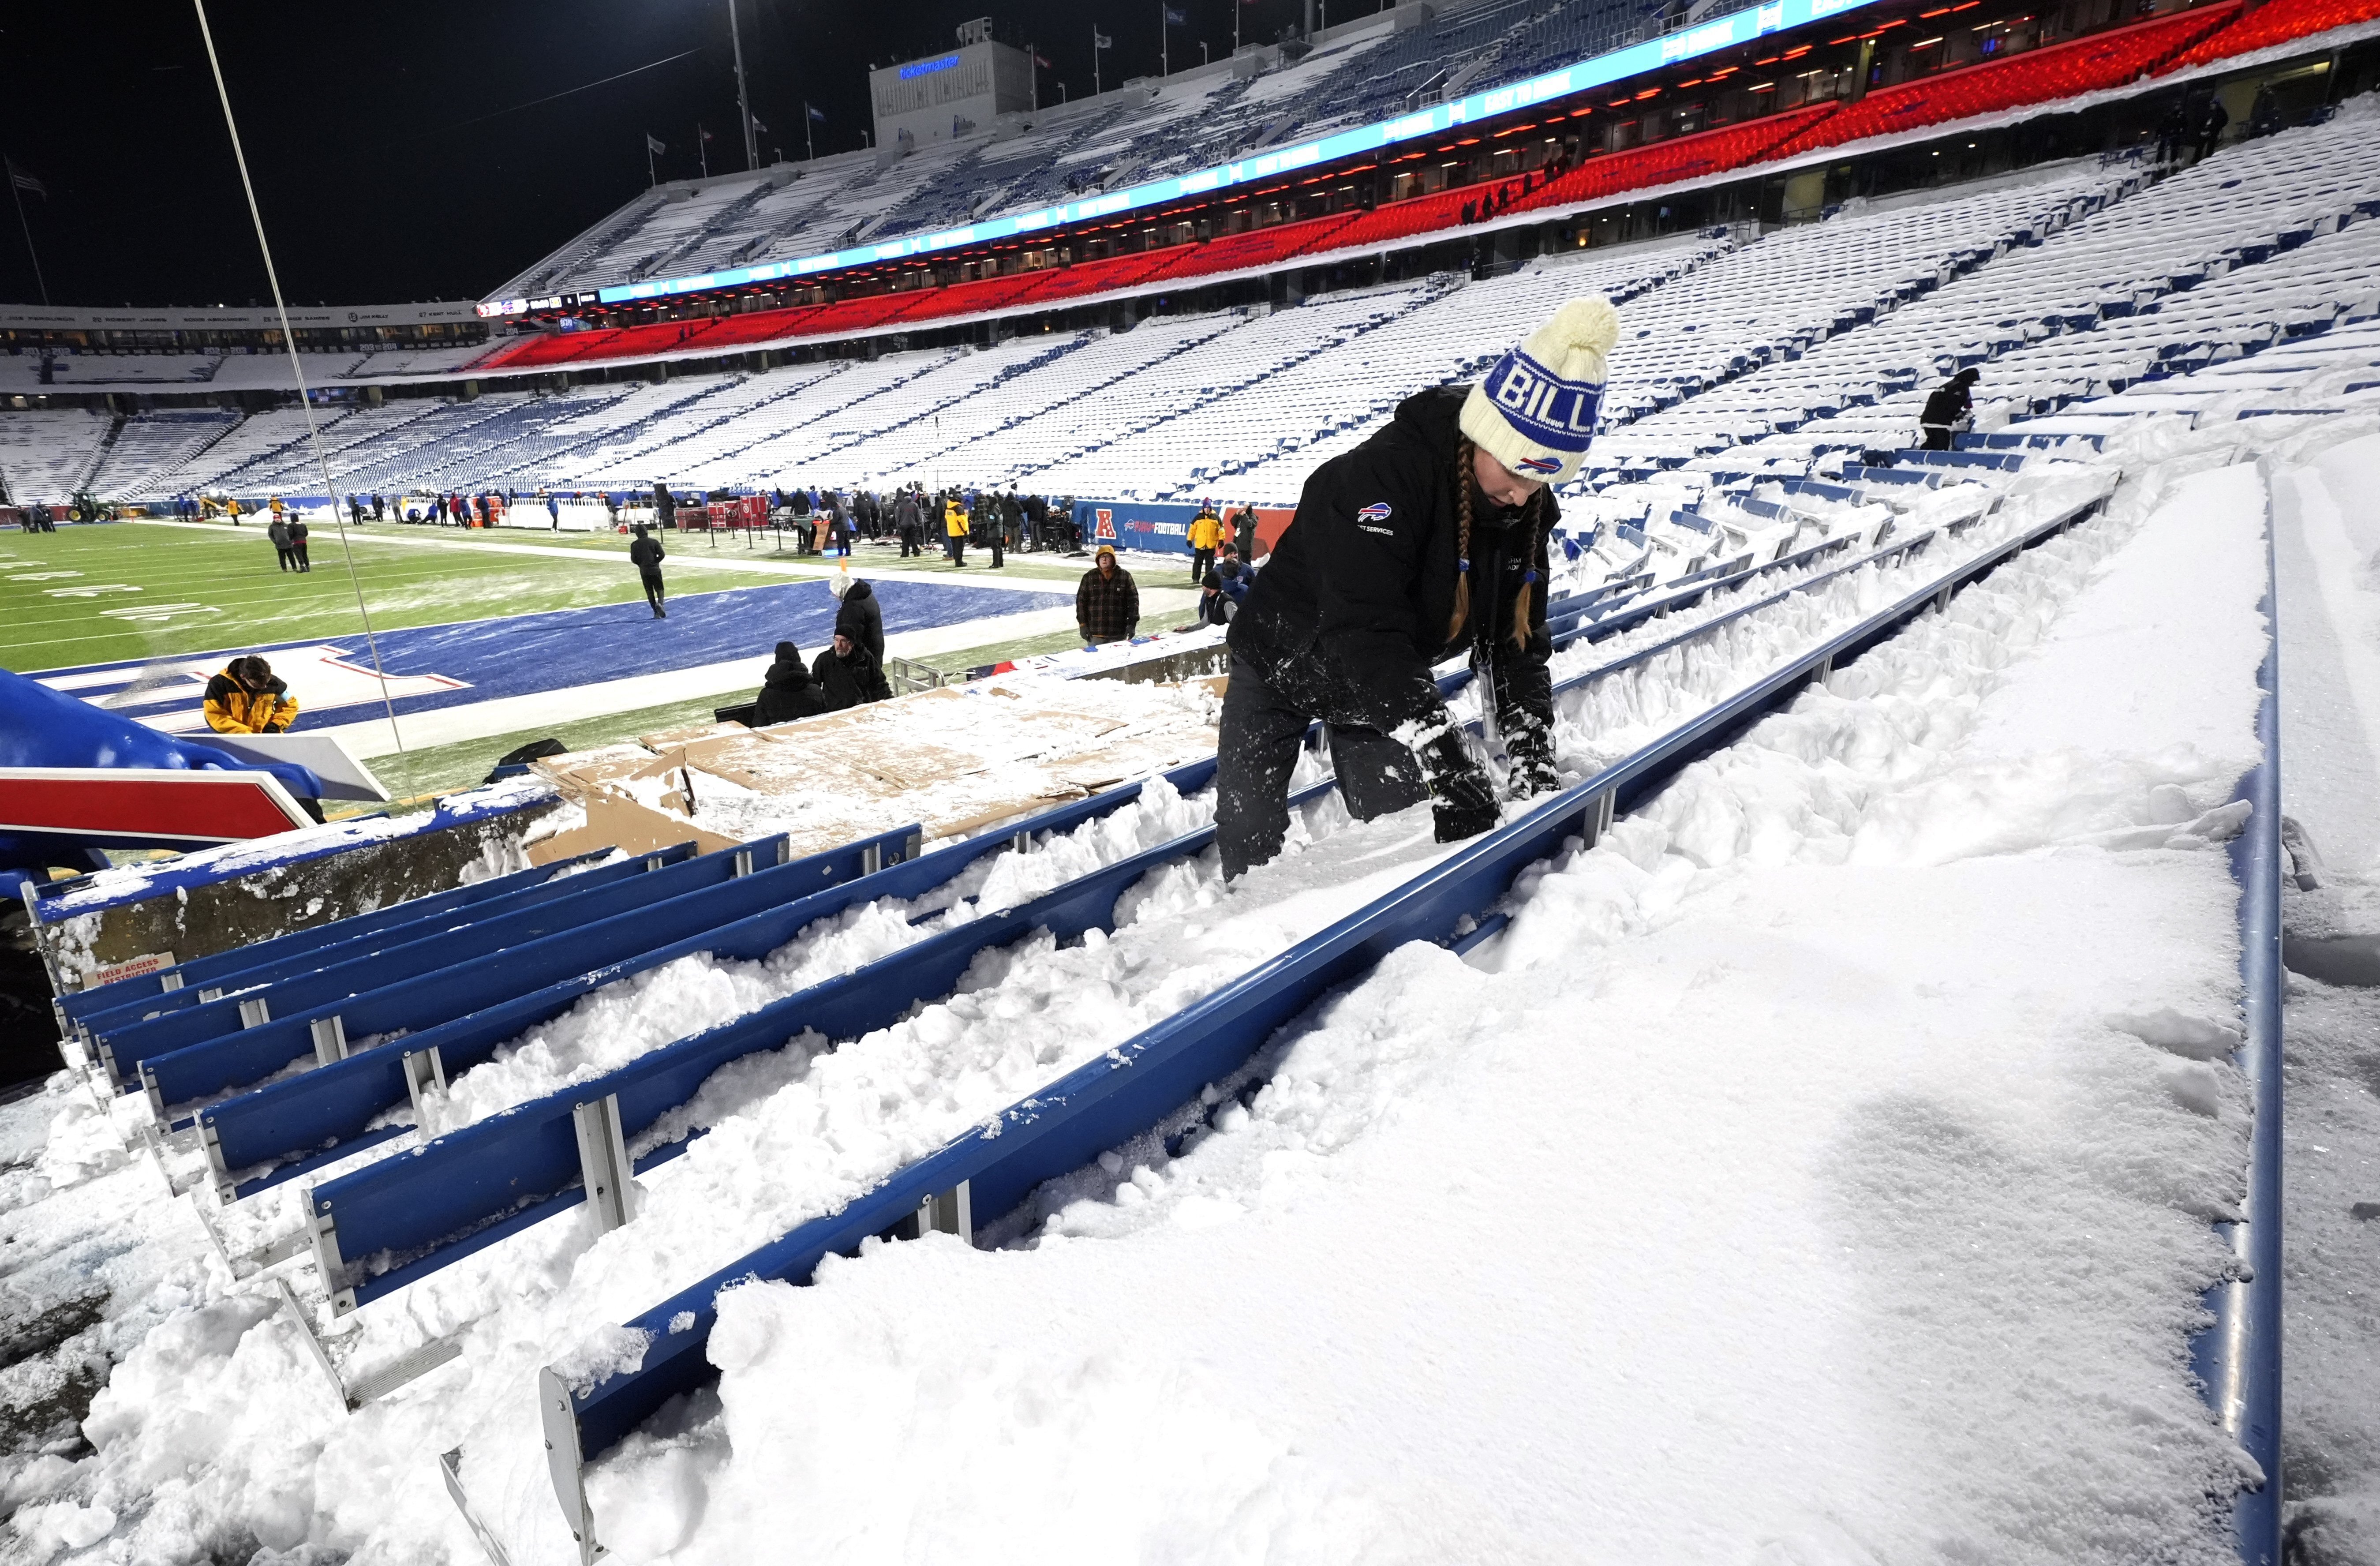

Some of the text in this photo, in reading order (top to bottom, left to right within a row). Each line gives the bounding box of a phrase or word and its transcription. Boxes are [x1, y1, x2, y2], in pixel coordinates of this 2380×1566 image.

[900, 56, 960, 80] ticketmaster
[1485, 89, 1515, 113] EASY
[1516, 83, 1532, 104] TO
[1496, 363, 1604, 433] BILL
[1153, 522, 1186, 536] FOOTBALL
[1366, 526, 1394, 536] SERVICES
[97, 958, 159, 980] FIELD ACCESS
